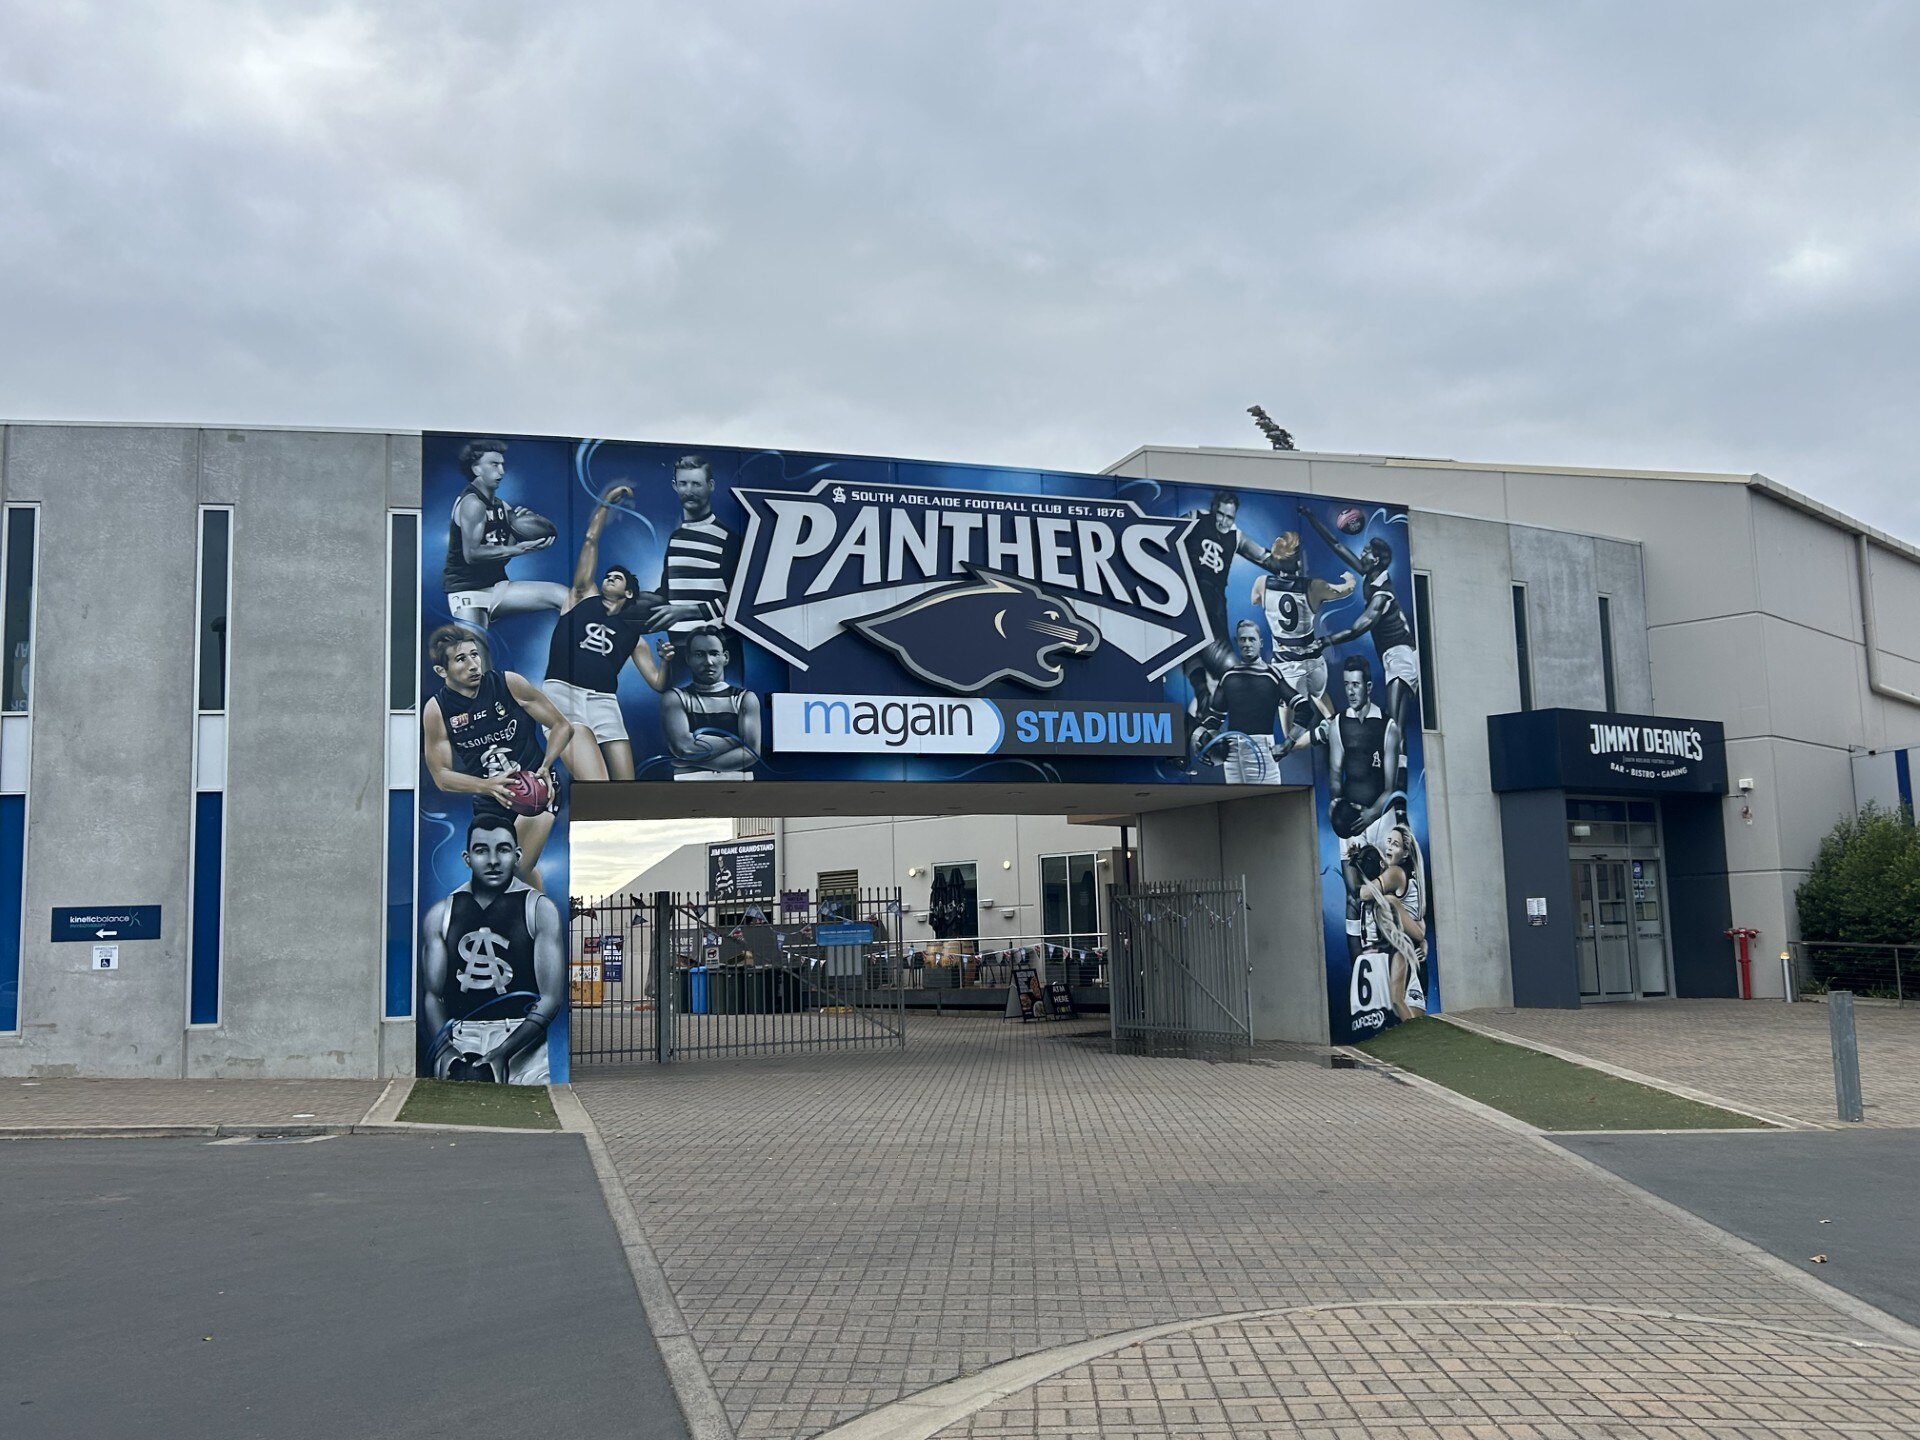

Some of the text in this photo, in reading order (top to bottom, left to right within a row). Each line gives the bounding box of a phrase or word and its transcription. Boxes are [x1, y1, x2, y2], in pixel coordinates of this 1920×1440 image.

[851, 490, 894, 503] SOUTH
[899, 494, 961, 507] ADELAIDE
[965, 499, 1028, 512] FOOTBALL
[1031, 503, 1062, 514] CLUB
[1068, 505, 1093, 516] EST.
[1097, 507, 1125, 518] 1876
[753, 498, 1189, 618] PANTHERS
[1278, 593, 1299, 632] 9
[804, 699, 1173, 747] magain STADIUM
[1590, 724, 1703, 761] JIMMY DEANE'S
[1610, 762, 1688, 779] BAR BISTRO GAMING
[710, 848, 720, 857] JIM
[739, 843, 774, 853] GRANDSTAND
[69, 915, 130, 924] kineticbalance
[1052, 985, 1066, 993] ATM
[1357, 958, 1373, 1007] 6
[1054, 995, 1069, 1003] HERE
